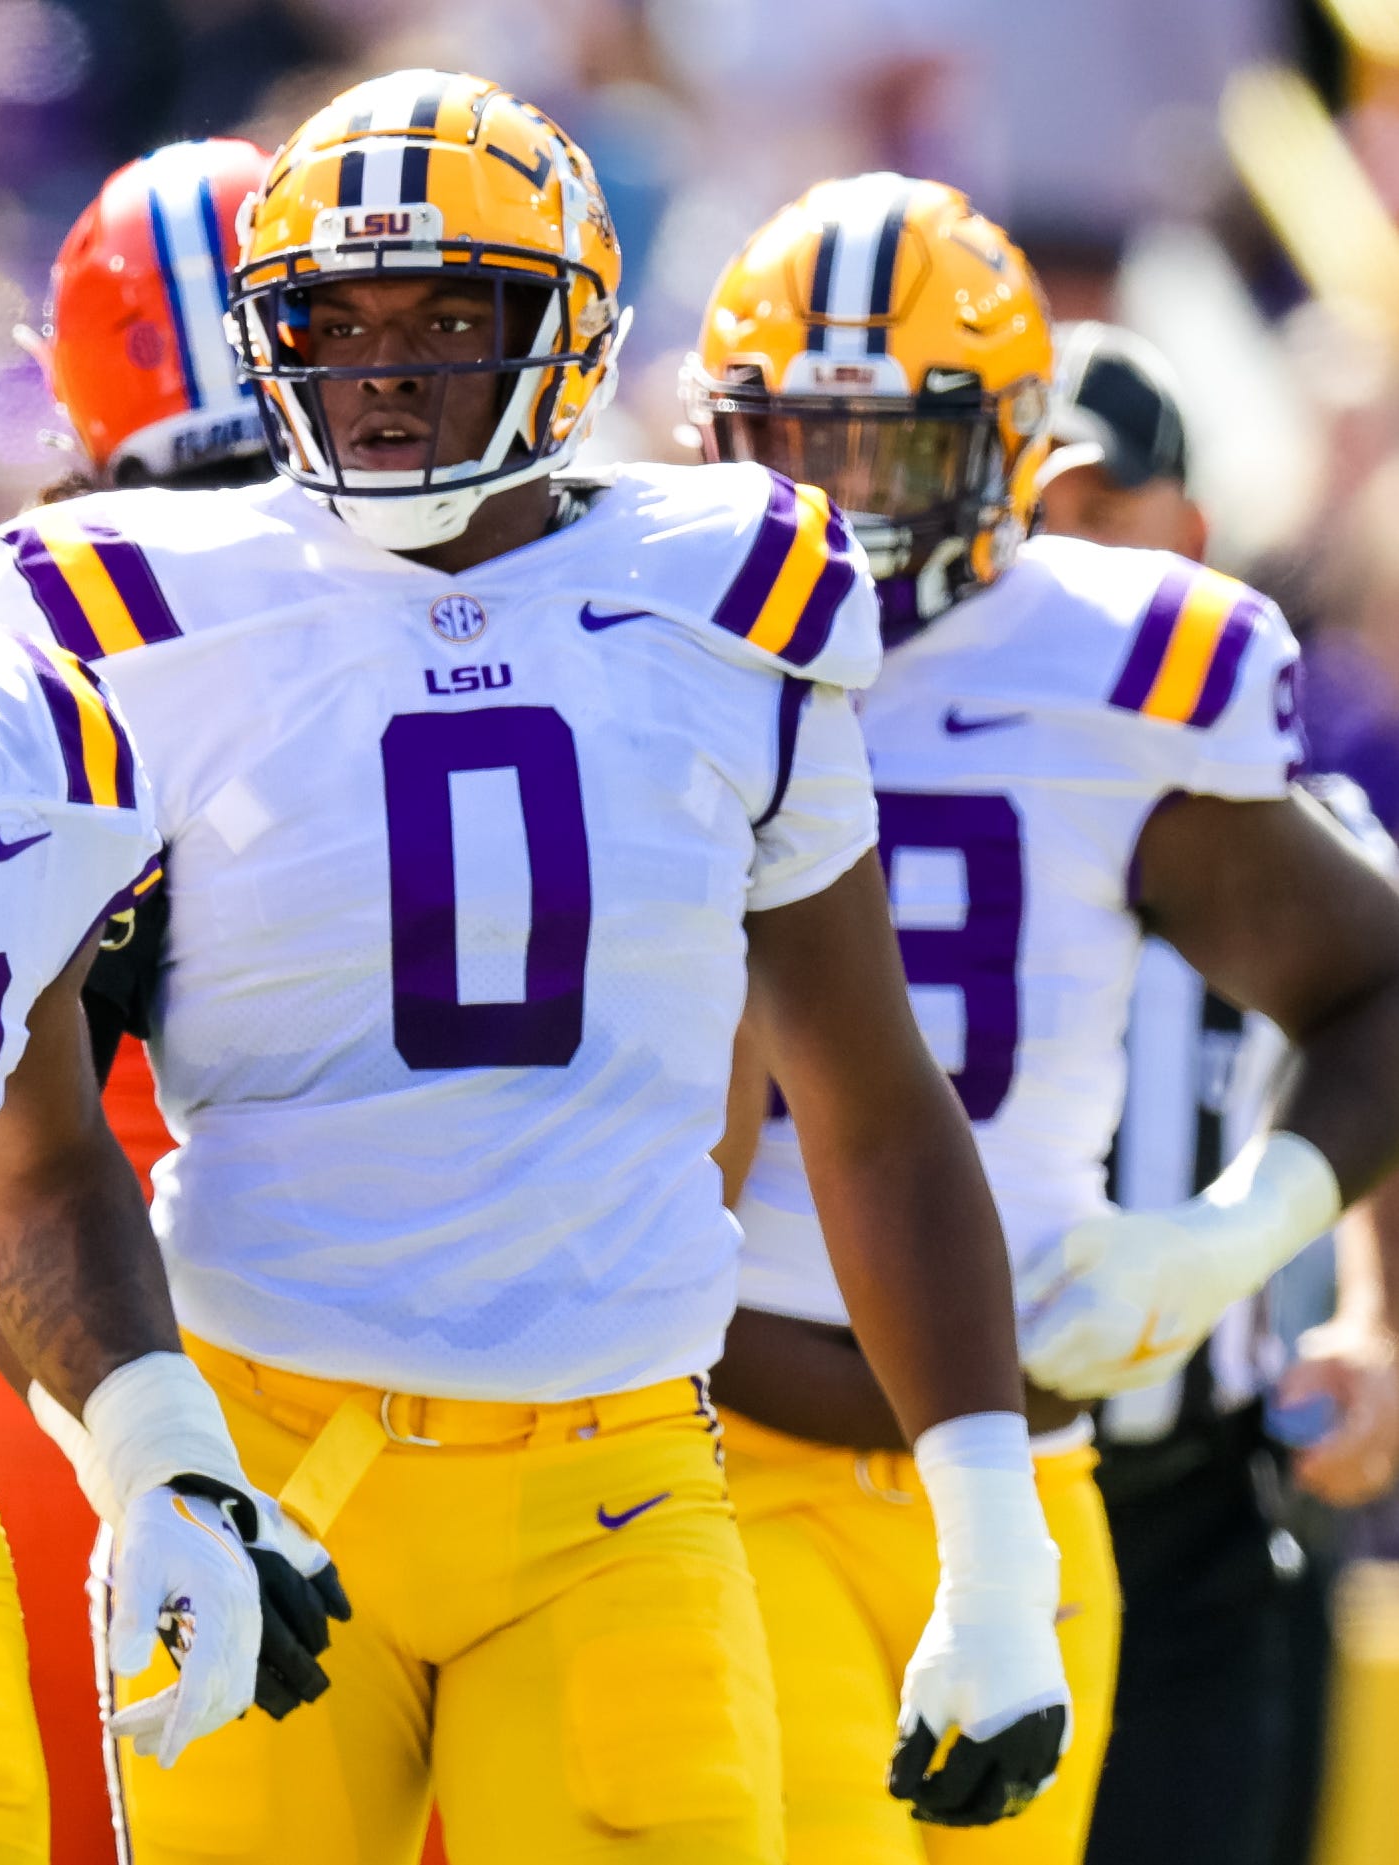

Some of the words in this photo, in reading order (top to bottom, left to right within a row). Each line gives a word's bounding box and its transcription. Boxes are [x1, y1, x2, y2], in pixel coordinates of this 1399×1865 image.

[344, 212, 410, 238] LSU
[431, 598, 484, 639] SEC
[425, 663, 512, 695] LSU
[381, 706, 592, 1071] 0
